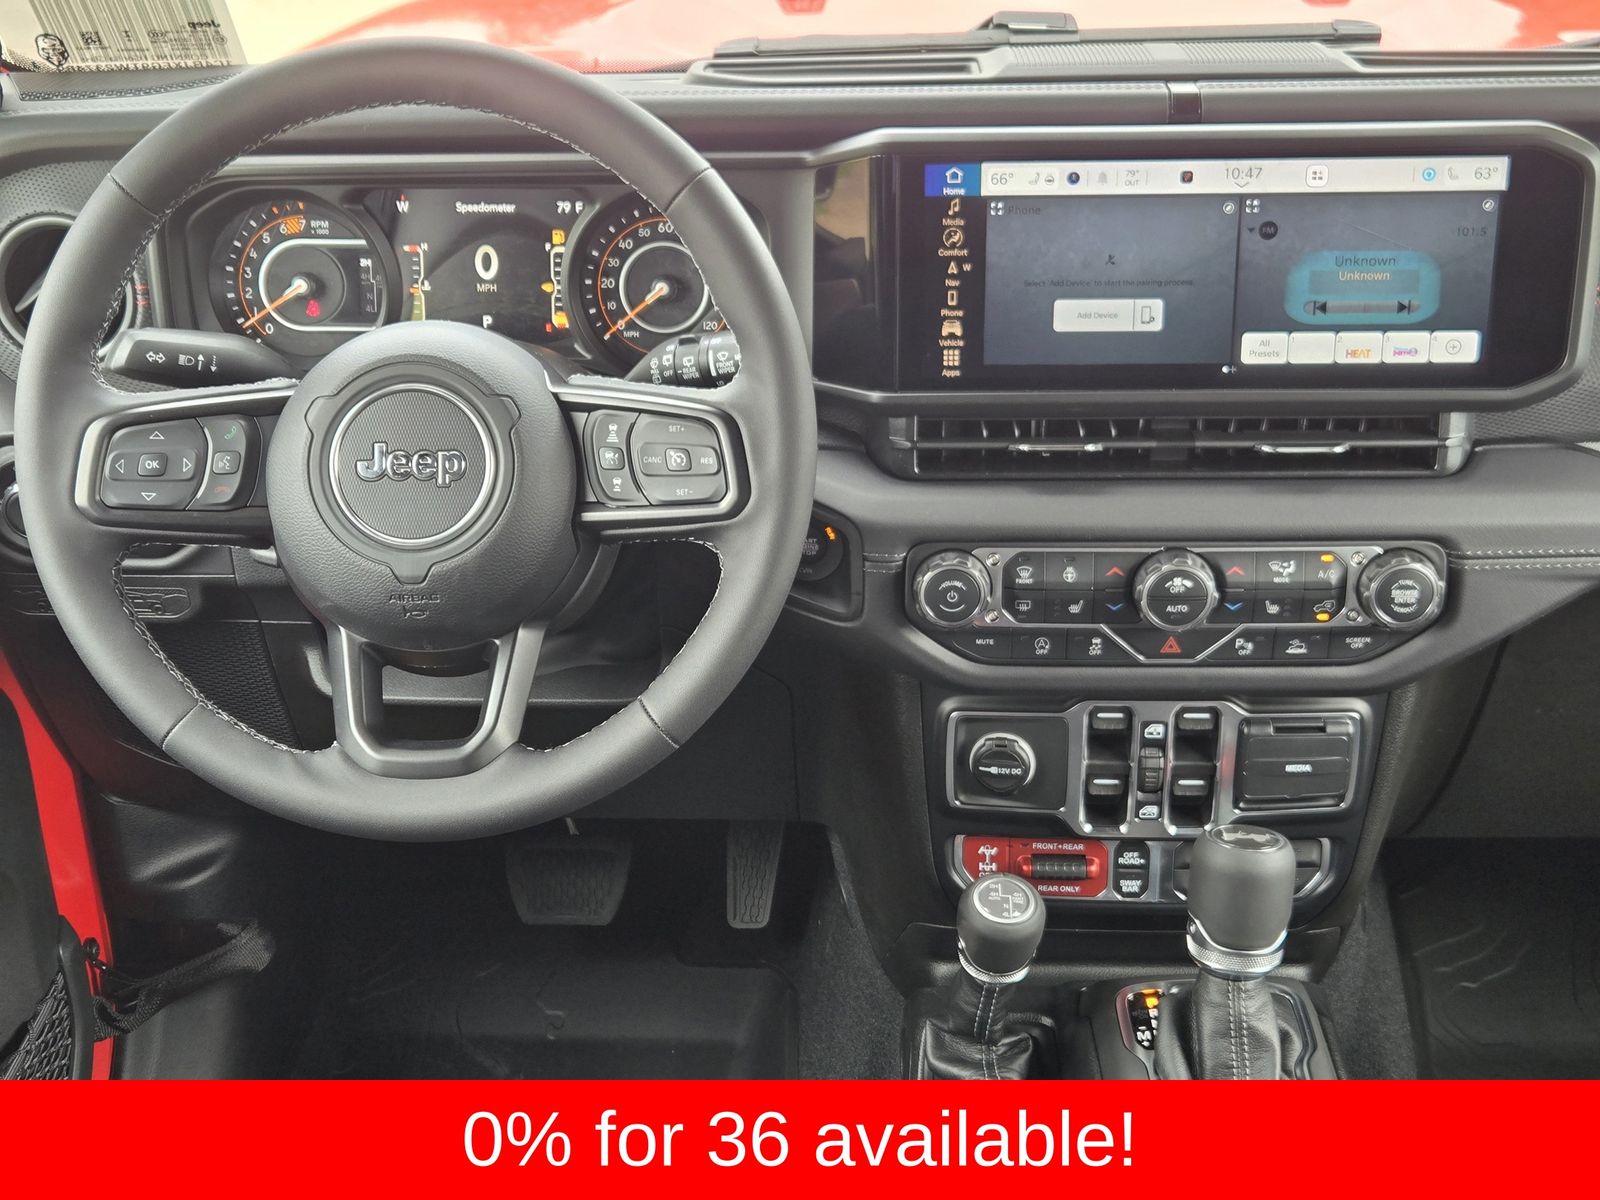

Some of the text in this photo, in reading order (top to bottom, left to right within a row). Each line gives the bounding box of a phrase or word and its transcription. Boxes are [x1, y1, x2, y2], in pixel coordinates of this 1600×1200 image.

[1224, 167, 1263, 180] 10:47
[943, 187, 966, 196] Home
[396, 201, 409, 213] W
[455, 202, 516, 215] Speedometer
[556, 201, 571, 214] 79
[1008, 205, 1042, 216] Phone
[299, 219, 306, 230] 7
[310, 221, 329, 229] RPM
[942, 218, 965, 226] Media
[279, 223, 287, 234] 6
[658, 222, 674, 233] 60
[1457, 227, 1487, 238] 101.5
[638, 228, 650, 238] 50
[262, 233, 271, 244] 5
[618, 239, 633, 250] 40
[249, 249, 258, 260] 4
[938, 249, 968, 258] Comfort
[474, 244, 499, 280] 0
[608, 258, 619, 267] 30
[1335, 255, 1396, 267] Unknown
[244, 267, 252, 278] 3
[1338, 271, 1391, 282] Unknown
[477, 283, 497, 292] MPH
[601, 279, 615, 289] 20
[945, 278, 960, 287] Nav
[245, 288, 253, 299] 2
[607, 301, 617, 311] 10
[940, 309, 964, 318] Phone
[1077, 311, 1119, 320] Add Device
[482, 316, 492, 328] P
[702, 322, 718, 330] 120
[265, 323, 274, 334] 0
[938, 339, 964, 348] Vehicle
[1259, 339, 1271, 348] All
[1249, 350, 1280, 358] Presets
[1345, 349, 1372, 359] HEAT
[716, 360, 734, 368] FRONT
[682, 372, 700, 380] WIPER
[718, 367, 736, 375] WIPER
[942, 369, 961, 378] Apps
[145, 460, 160, 469] OK
[356, 442, 467, 487] Jeep
[700, 457, 713, 465] RES
[1170, 586, 1185, 594] OFF
[389, 594, 440, 604] AIRBAG
[1166, 604, 1188, 612] AUTO
[1285, 764, 1312, 773] MEDIA
[1032, 842, 1084, 850] FRONT+REAR
[1122, 885, 1139, 893] BAR
